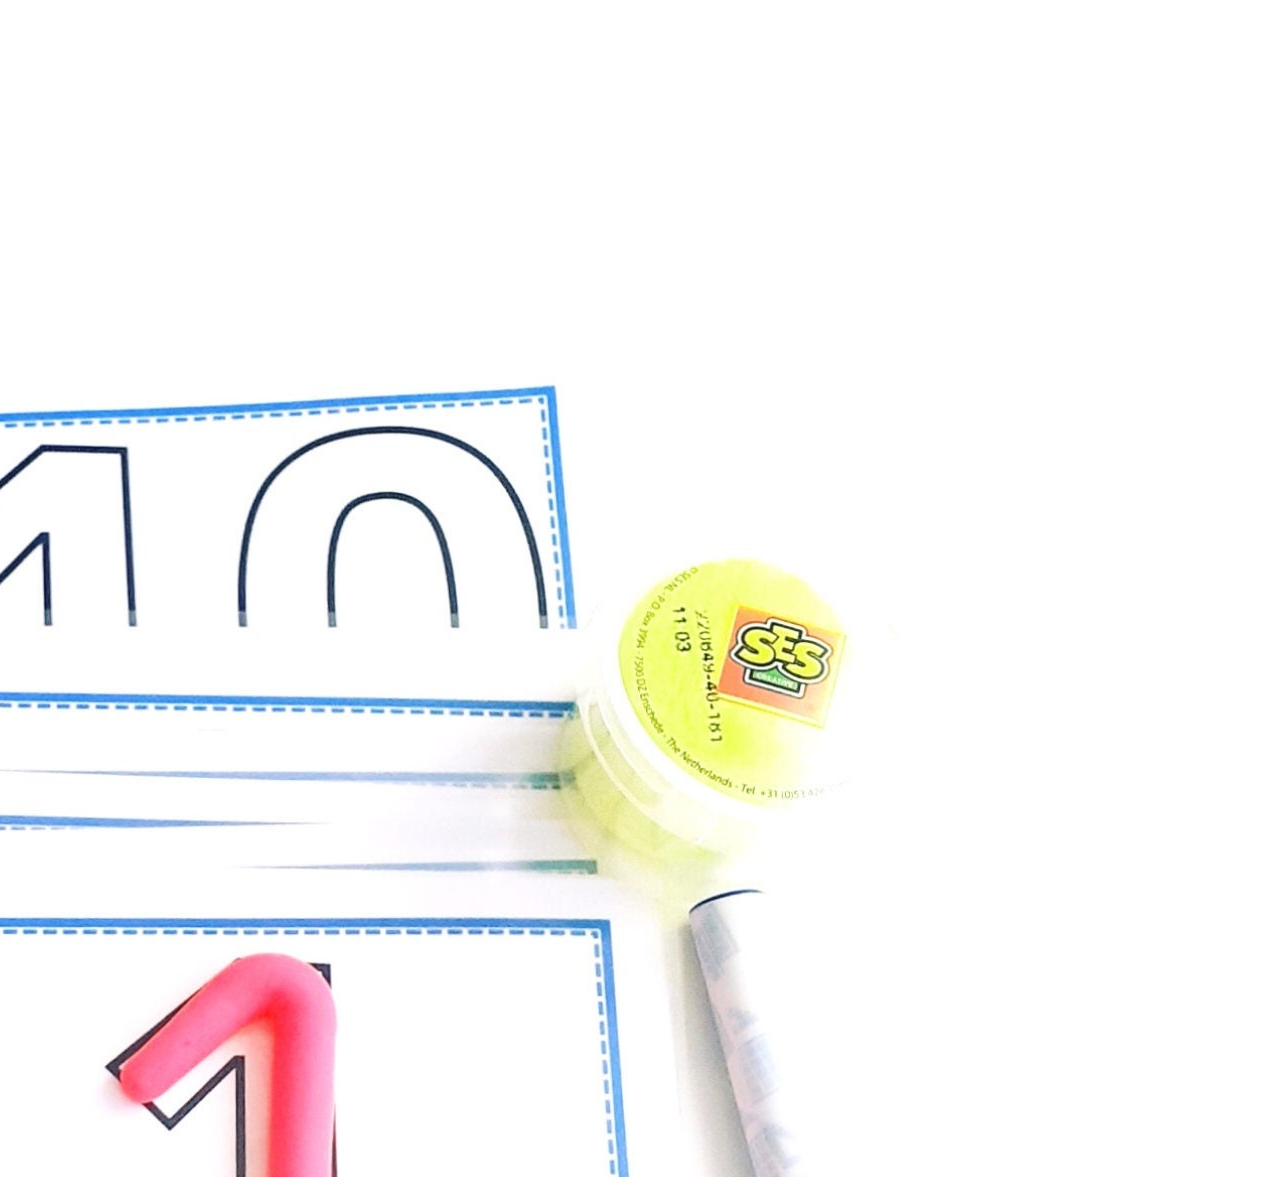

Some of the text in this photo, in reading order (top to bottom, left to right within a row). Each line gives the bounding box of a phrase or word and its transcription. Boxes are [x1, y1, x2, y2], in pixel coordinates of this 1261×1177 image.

[734, 622, 828, 680] SES
[640, 692, 664, 734] Enschede
[666, 737, 680, 753] The
[680, 751, 732, 788] Netherlands
